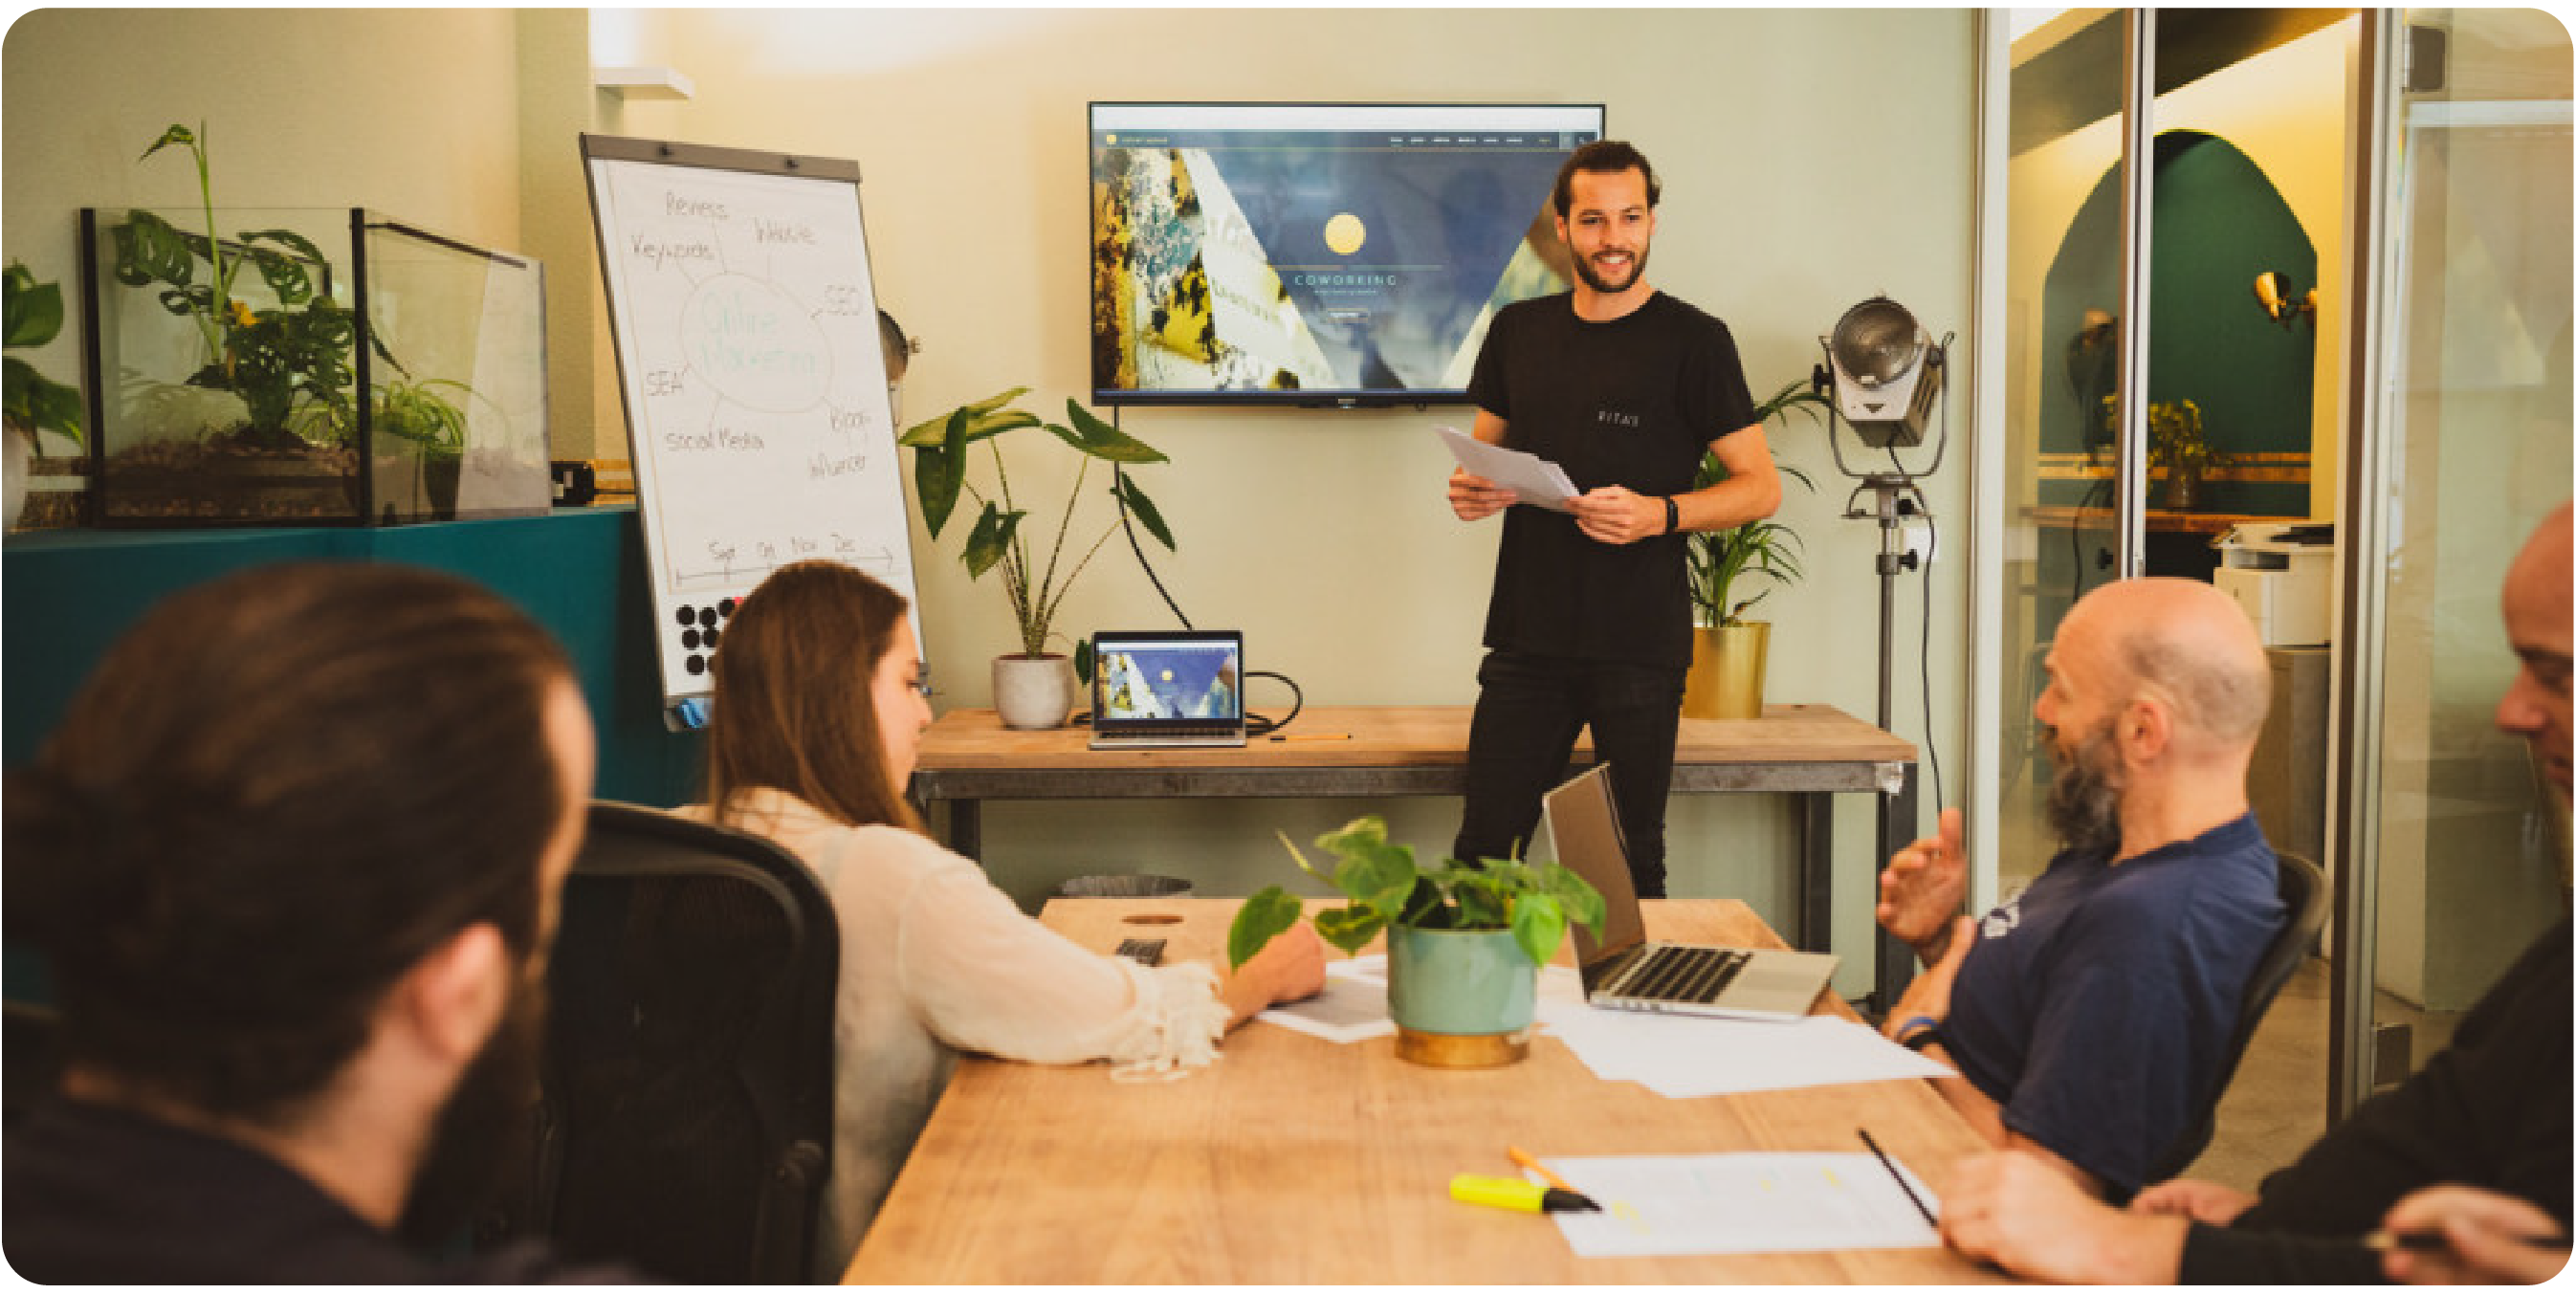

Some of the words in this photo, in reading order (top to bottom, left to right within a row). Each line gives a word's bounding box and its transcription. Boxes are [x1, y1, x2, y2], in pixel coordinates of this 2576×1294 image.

[1293, 274, 1398, 287] COWORKING
[824, 283, 864, 318] SEO
[646, 369, 684, 396] SEA
